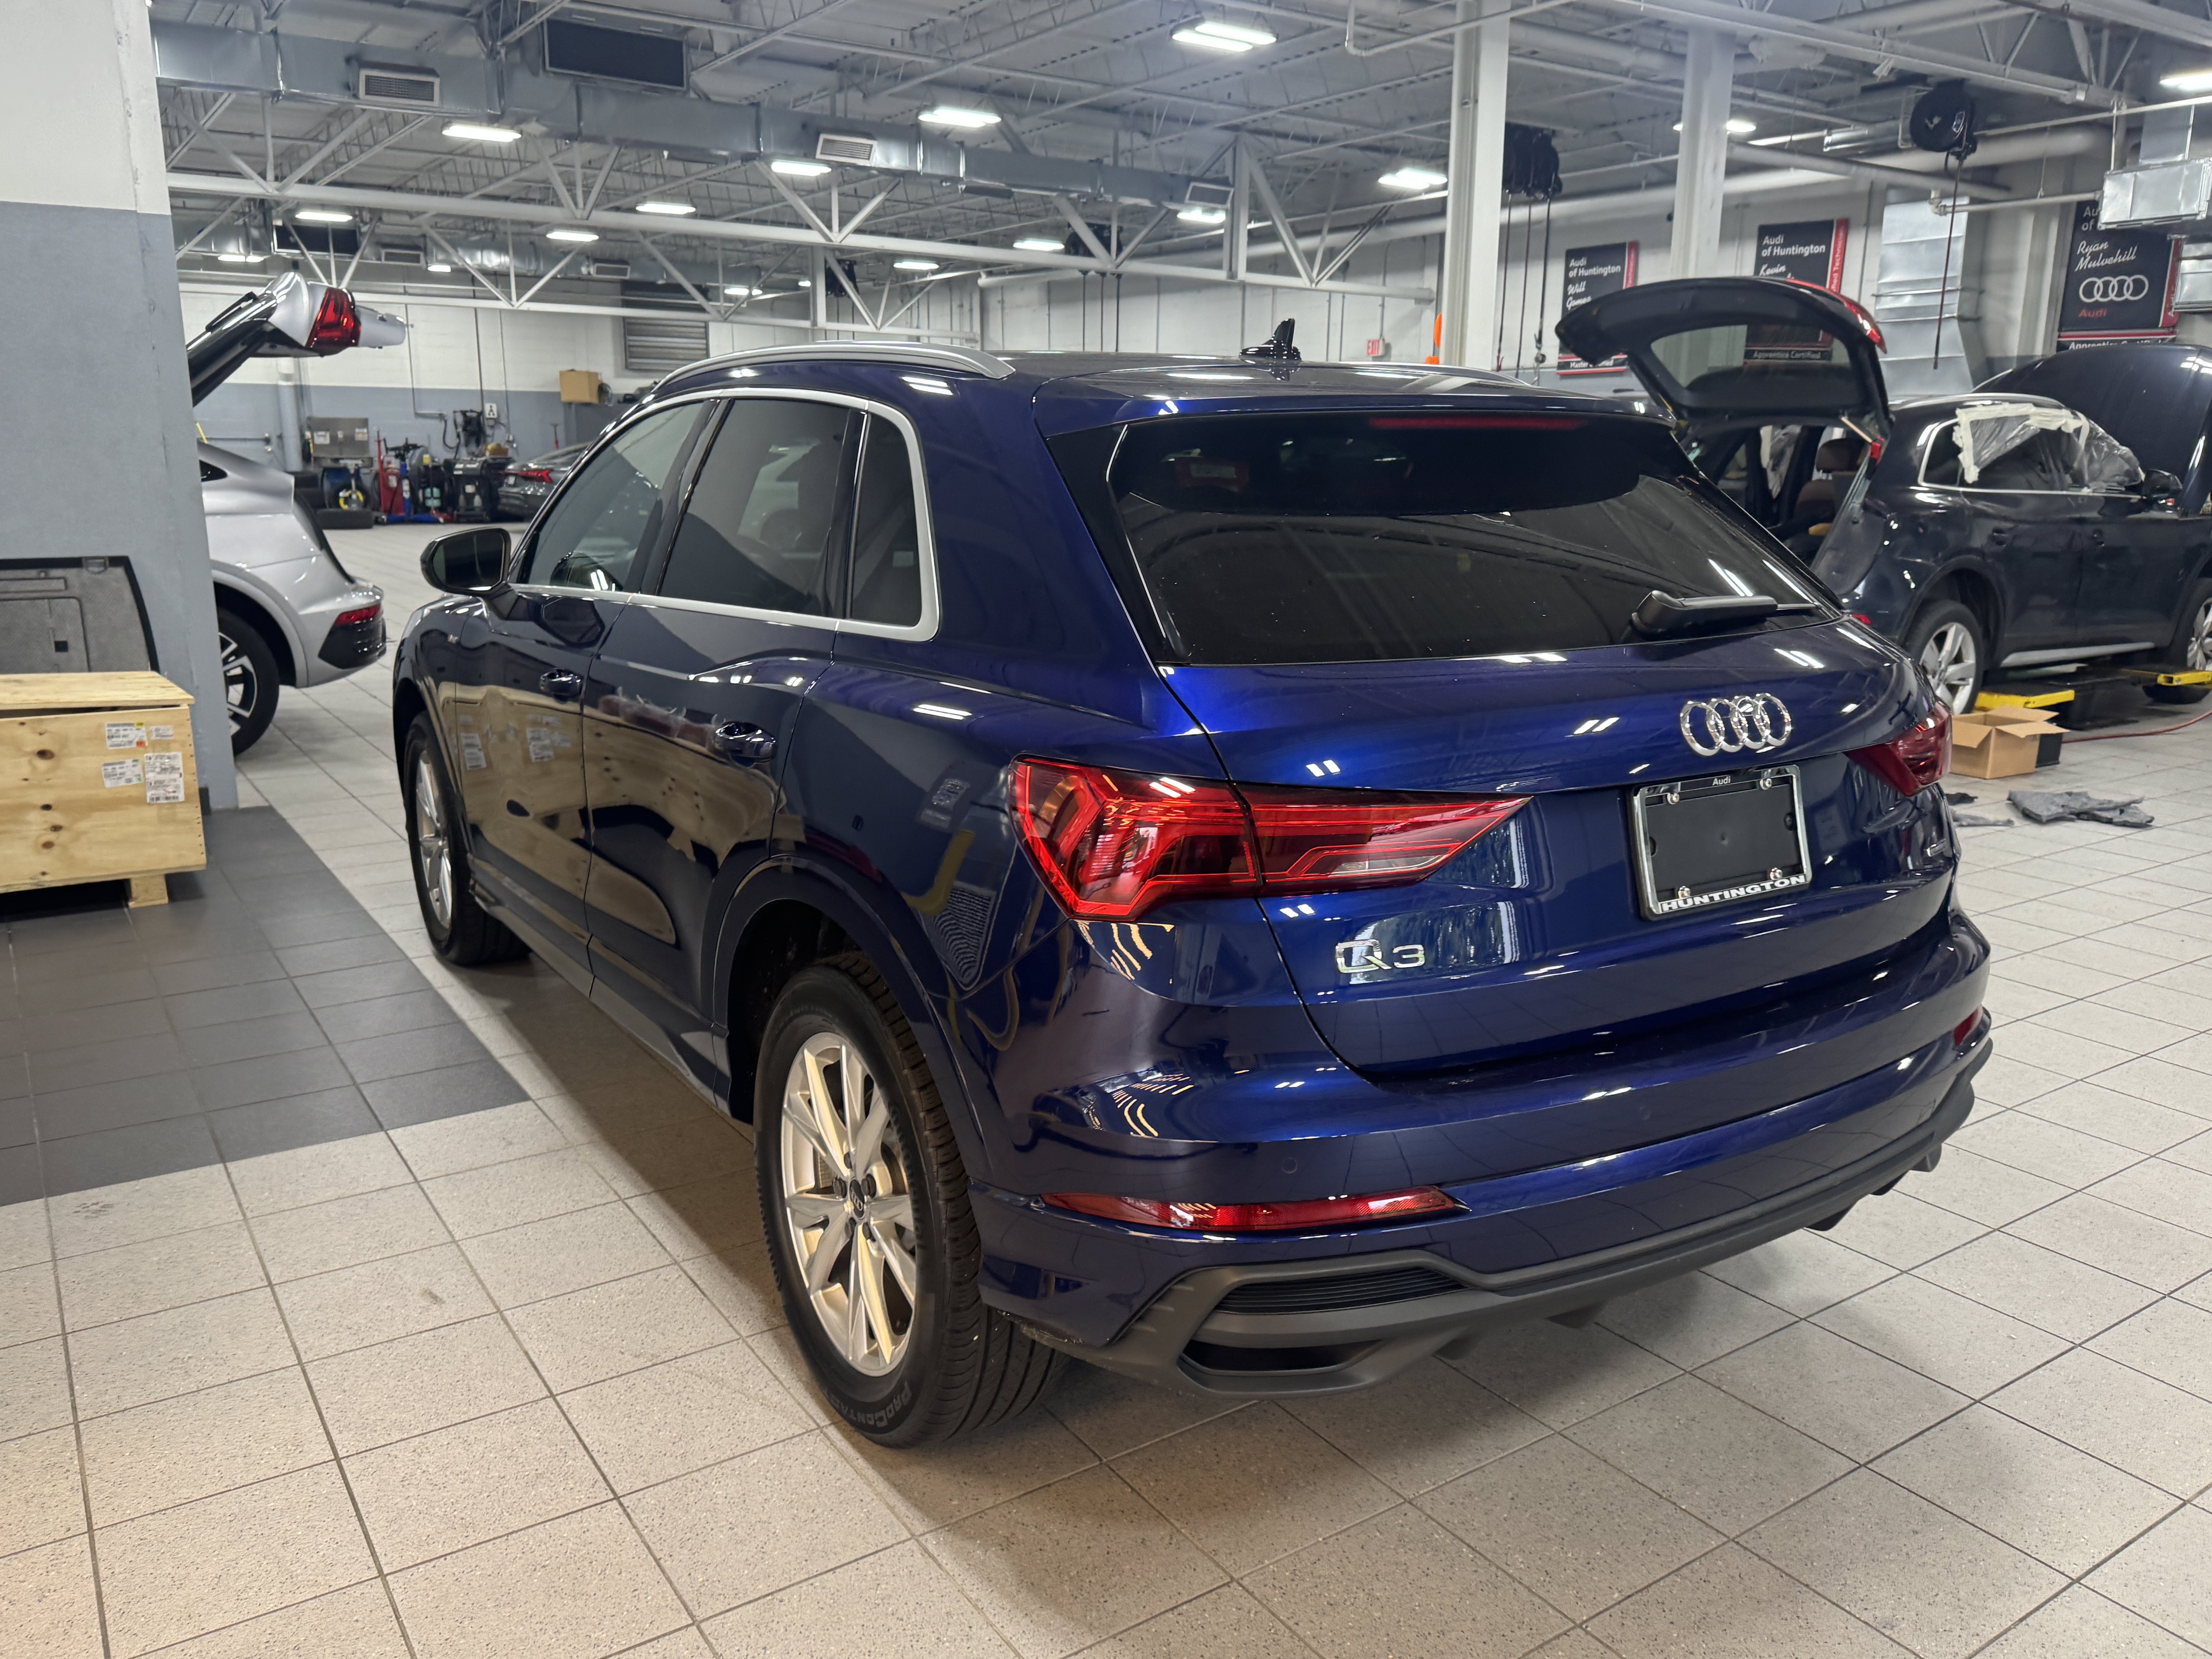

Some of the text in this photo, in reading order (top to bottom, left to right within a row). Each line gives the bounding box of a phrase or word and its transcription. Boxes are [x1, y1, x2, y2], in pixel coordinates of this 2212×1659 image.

[2083, 206, 2099, 218] Au
[2081, 219, 2095, 231] of
[1763, 234, 1784, 245] Audi
[1762, 244, 1826, 257] of Huntington
[2077, 240, 2109, 258] Ryan
[1569, 258, 1586, 267] Audi
[1568, 265, 1621, 278] of Huntington
[1759, 263, 1786, 276] Kevin
[1568, 280, 1587, 295] Will
[2078, 309, 2107, 318] Audi
[1366, 339, 1380, 356] EXIT
[1712, 776, 1731, 786] Audi
[1662, 875, 1806, 911] HUNTINGTON
[1336, 939, 1425, 974] Q3
